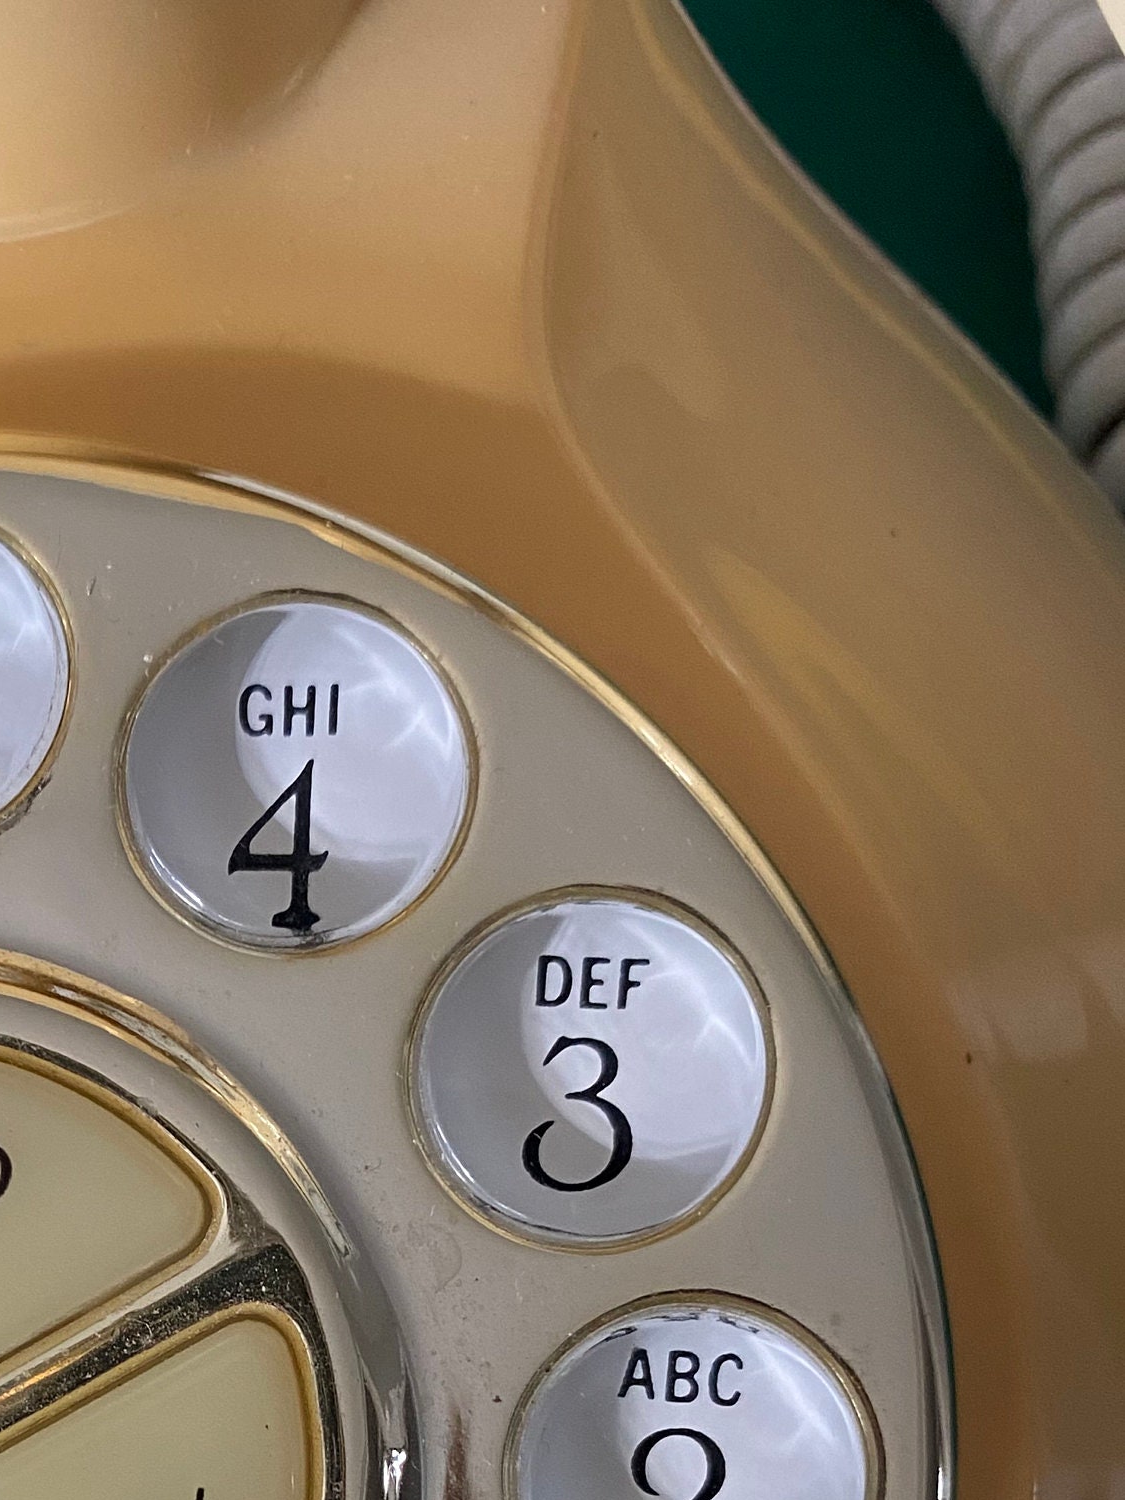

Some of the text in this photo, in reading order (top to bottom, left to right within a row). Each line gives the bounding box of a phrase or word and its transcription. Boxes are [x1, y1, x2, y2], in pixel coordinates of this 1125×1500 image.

[238, 682, 341, 740] GHI
[227, 759, 332, 937] 4
[535, 954, 650, 1009] DEF
[521, 1035, 633, 1193] 3
[617, 1347, 744, 1407] ABC
